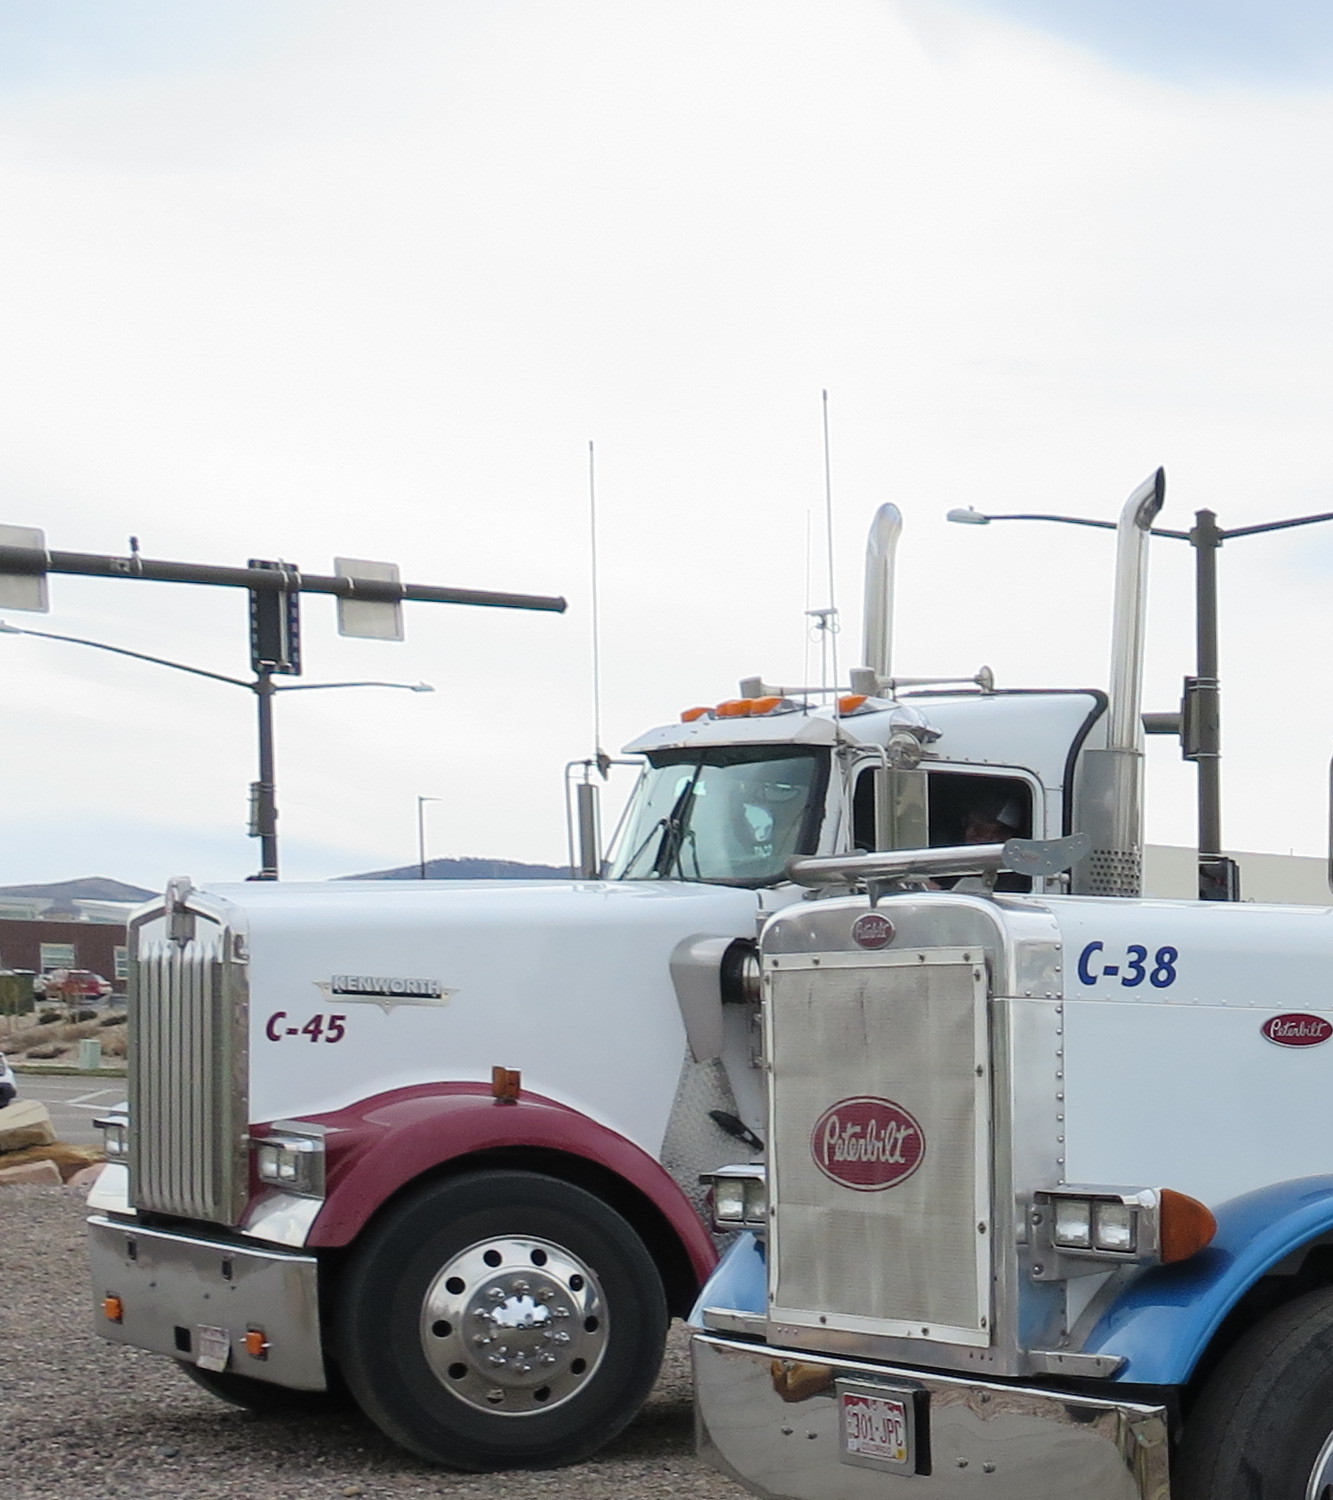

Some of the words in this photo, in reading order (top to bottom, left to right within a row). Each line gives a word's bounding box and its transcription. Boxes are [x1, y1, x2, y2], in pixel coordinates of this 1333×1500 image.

[1077, 940, 1179, 989] C-38
[331, 975, 443, 995] KENWORTH
[265, 1011, 347, 1044] C-45
[1270, 1019, 1328, 1038] Peterbilt
[823, 1114, 915, 1166] Peterbilt
